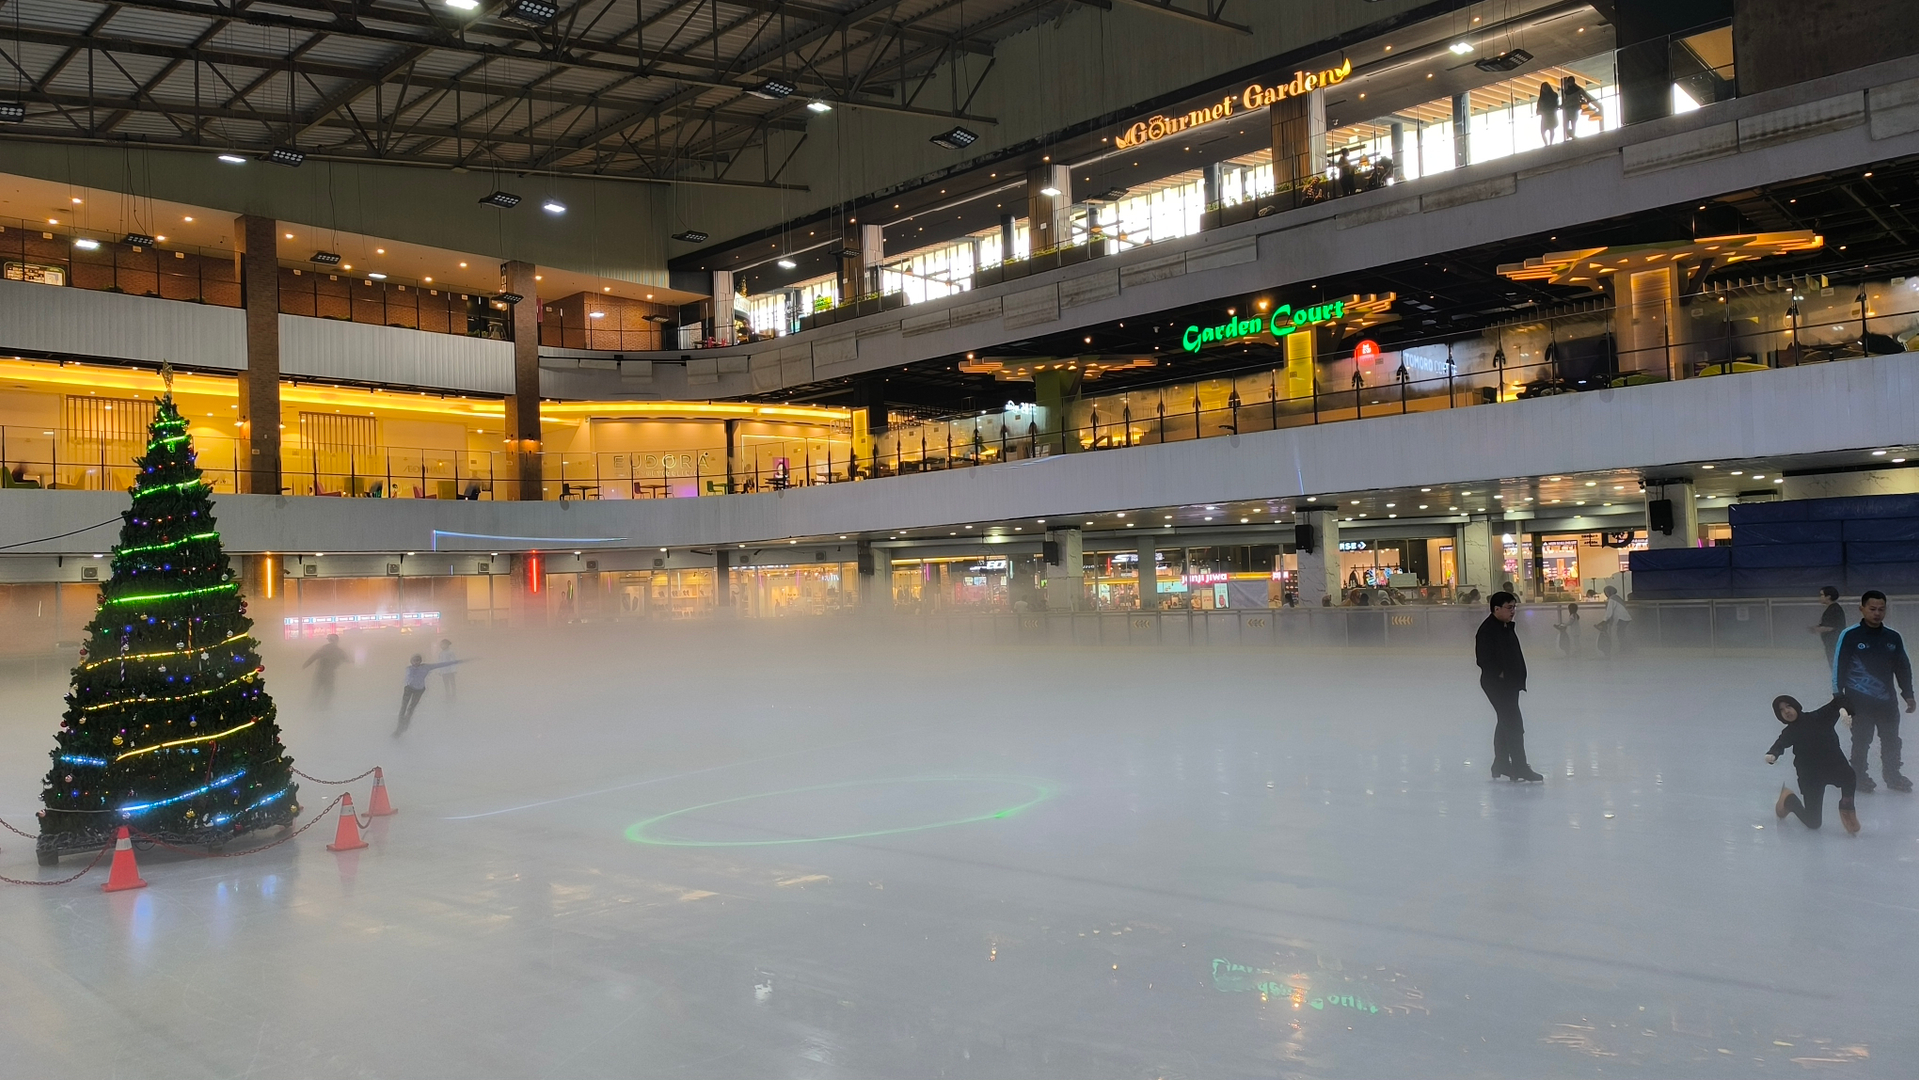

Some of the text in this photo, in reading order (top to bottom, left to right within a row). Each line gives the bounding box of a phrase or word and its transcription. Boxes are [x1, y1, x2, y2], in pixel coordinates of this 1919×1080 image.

[1124, 66, 1349, 147] Gourmet Garden
[1182, 303, 1344, 353] Garden Court
[1404, 352, 1433, 373] TOMORO
[613, 454, 709, 469] EUDORA
[1181, 572, 1228, 585] jnji jiwa
